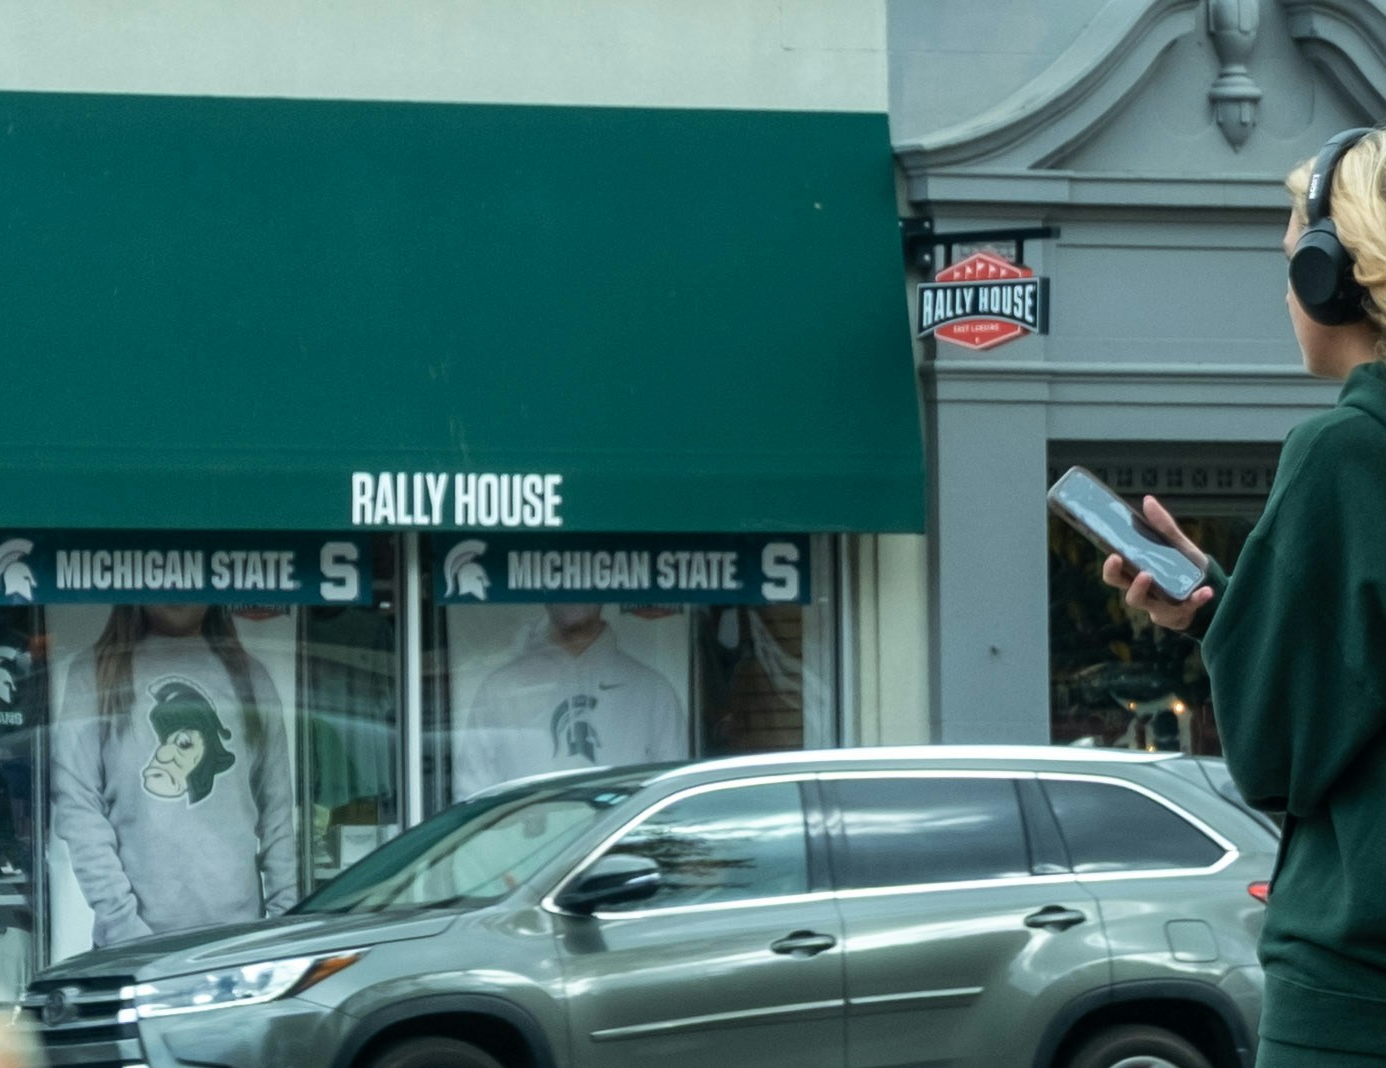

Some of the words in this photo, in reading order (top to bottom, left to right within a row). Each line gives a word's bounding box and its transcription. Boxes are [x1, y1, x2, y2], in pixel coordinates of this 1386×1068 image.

[923, 288, 974, 327] RALLY
[978, 284, 1036, 323] HOUSE
[351, 471, 449, 526] RALLY
[454, 472, 563, 527] HOUSE
[55, 551, 204, 590] MICHIGAN
[211, 551, 298, 590] STATE
[507, 551, 650, 590] MICHIGAN
[656, 551, 738, 590] STATE
